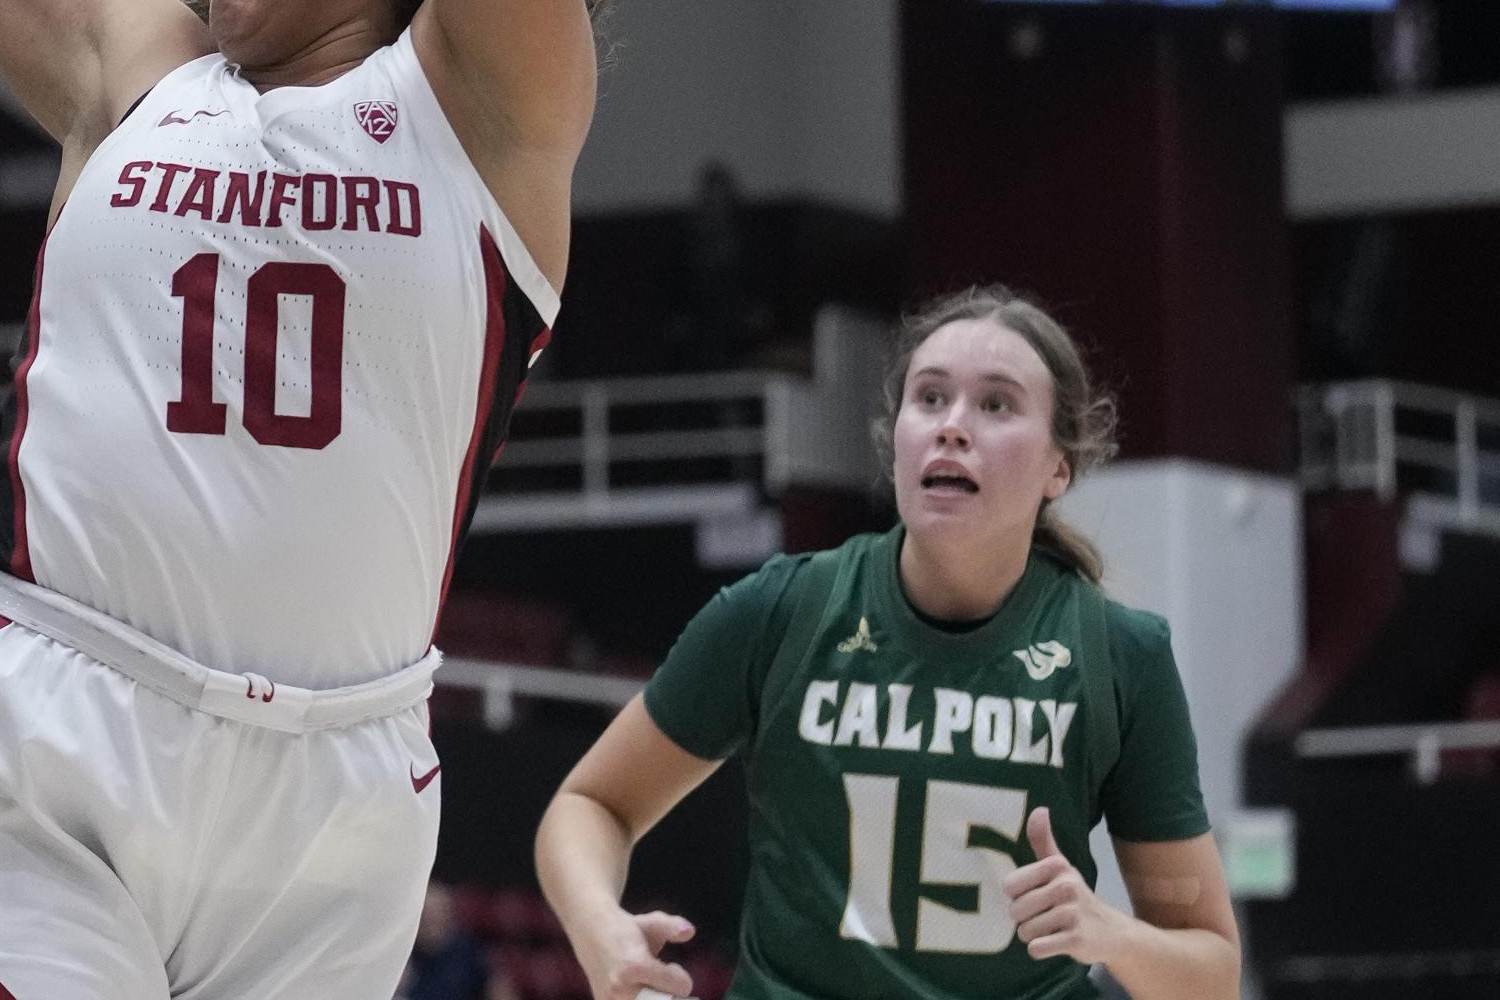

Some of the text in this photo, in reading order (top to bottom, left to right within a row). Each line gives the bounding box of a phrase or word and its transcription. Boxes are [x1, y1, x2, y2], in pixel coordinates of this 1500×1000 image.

[354, 101, 397, 126] PAC
[367, 117, 391, 135] 12
[110, 160, 422, 238] STANFORD
[166, 252, 347, 451] 10
[798, 680, 1079, 769] CAL POLY
[840, 772, 1028, 954] 15
